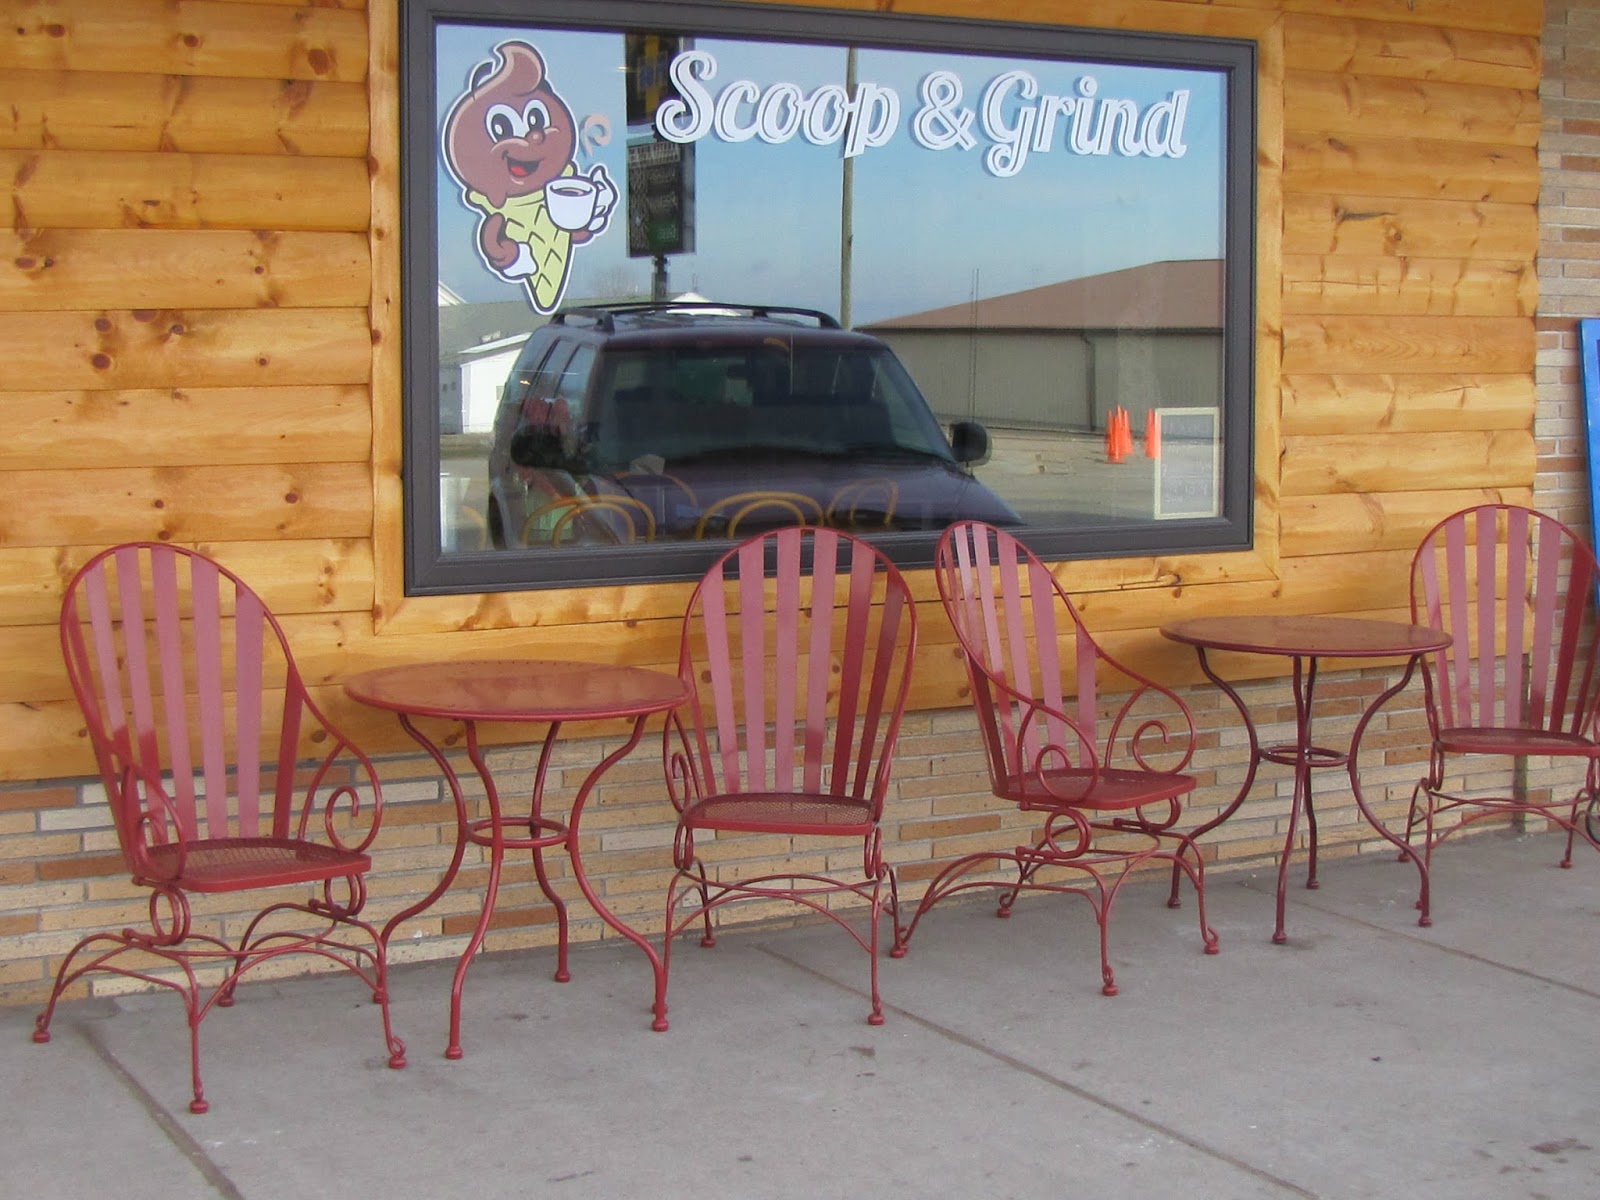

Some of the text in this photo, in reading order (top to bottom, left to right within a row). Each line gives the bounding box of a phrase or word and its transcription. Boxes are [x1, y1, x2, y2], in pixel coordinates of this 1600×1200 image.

[655, 51, 1189, 178] Scoop & Grind
